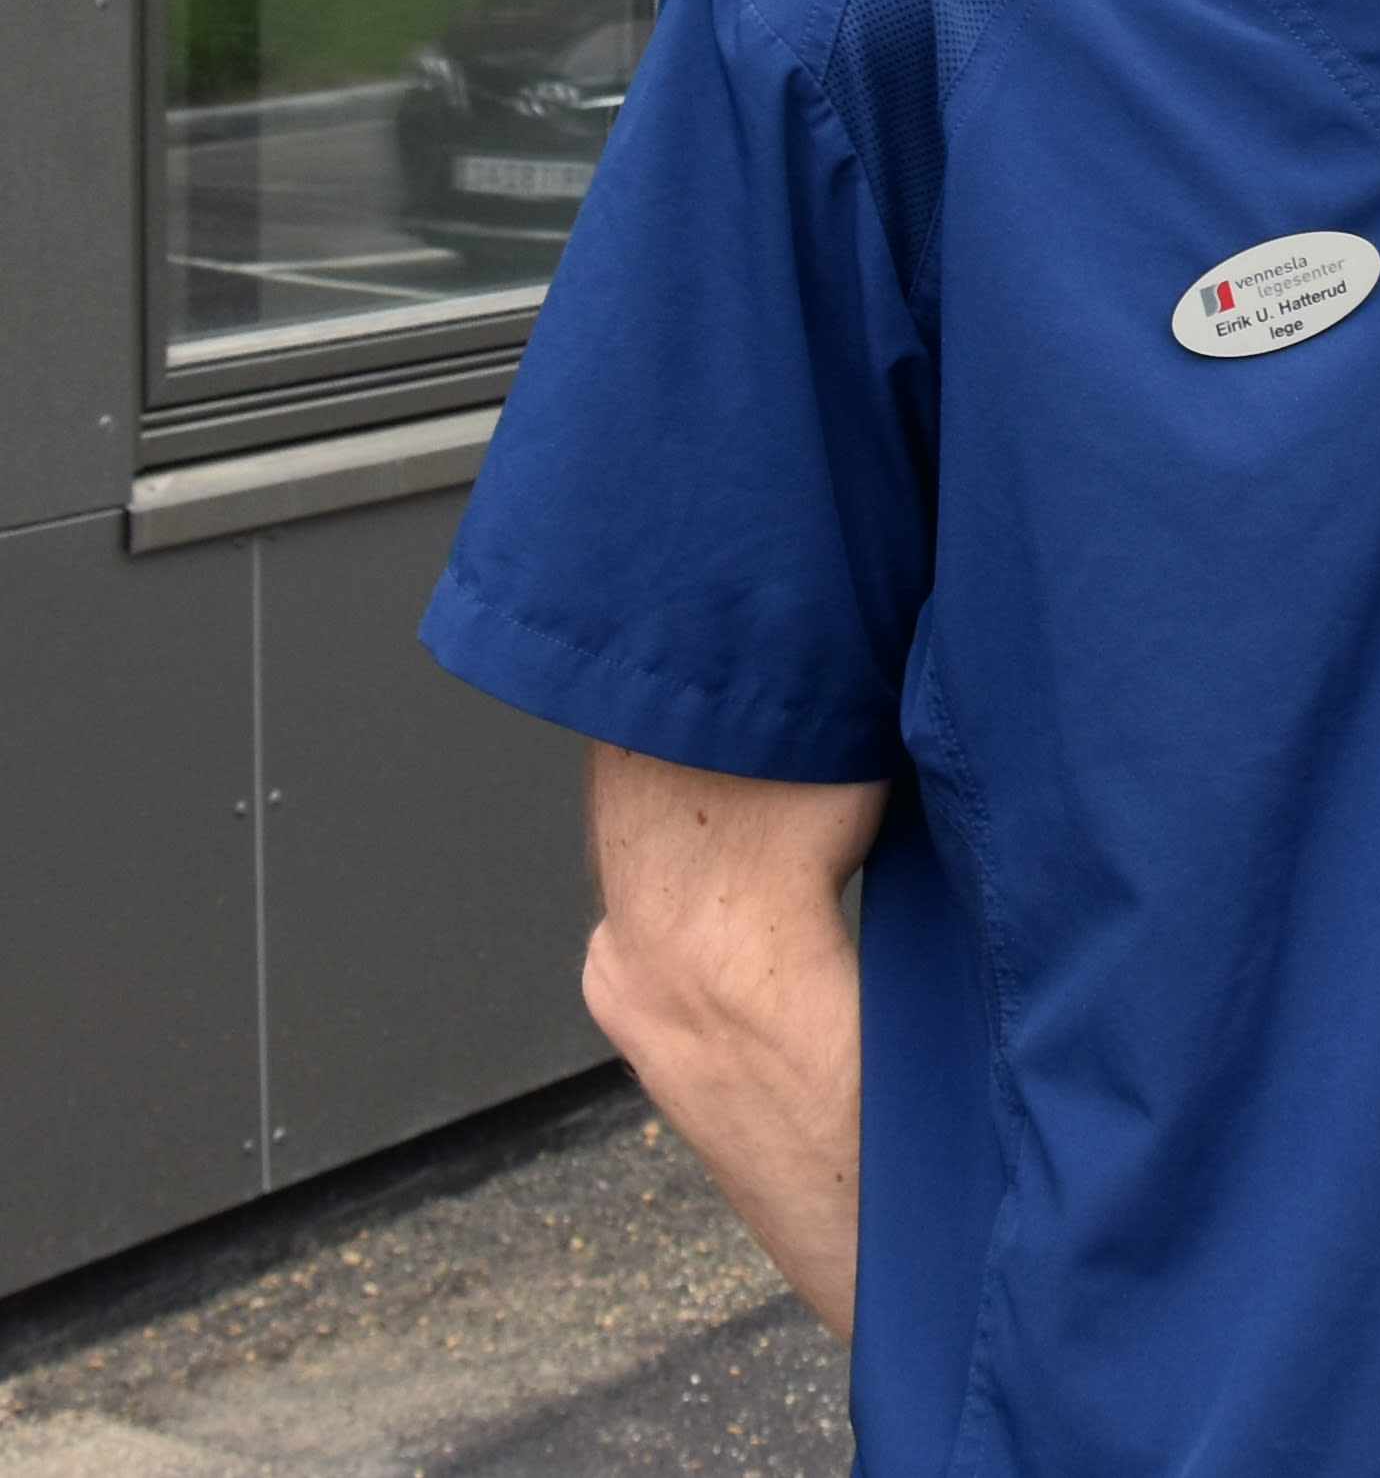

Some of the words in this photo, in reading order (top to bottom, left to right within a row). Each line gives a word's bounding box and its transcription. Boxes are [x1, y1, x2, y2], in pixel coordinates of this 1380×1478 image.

[1235, 256, 1308, 290] vennesla
[1257, 258, 1345, 299] legesenter
[1215, 315, 1252, 337] Eirik
[1256, 307, 1275, 323] U.
[1278, 279, 1347, 315] Hatterud
[1269, 319, 1304, 339] lege
